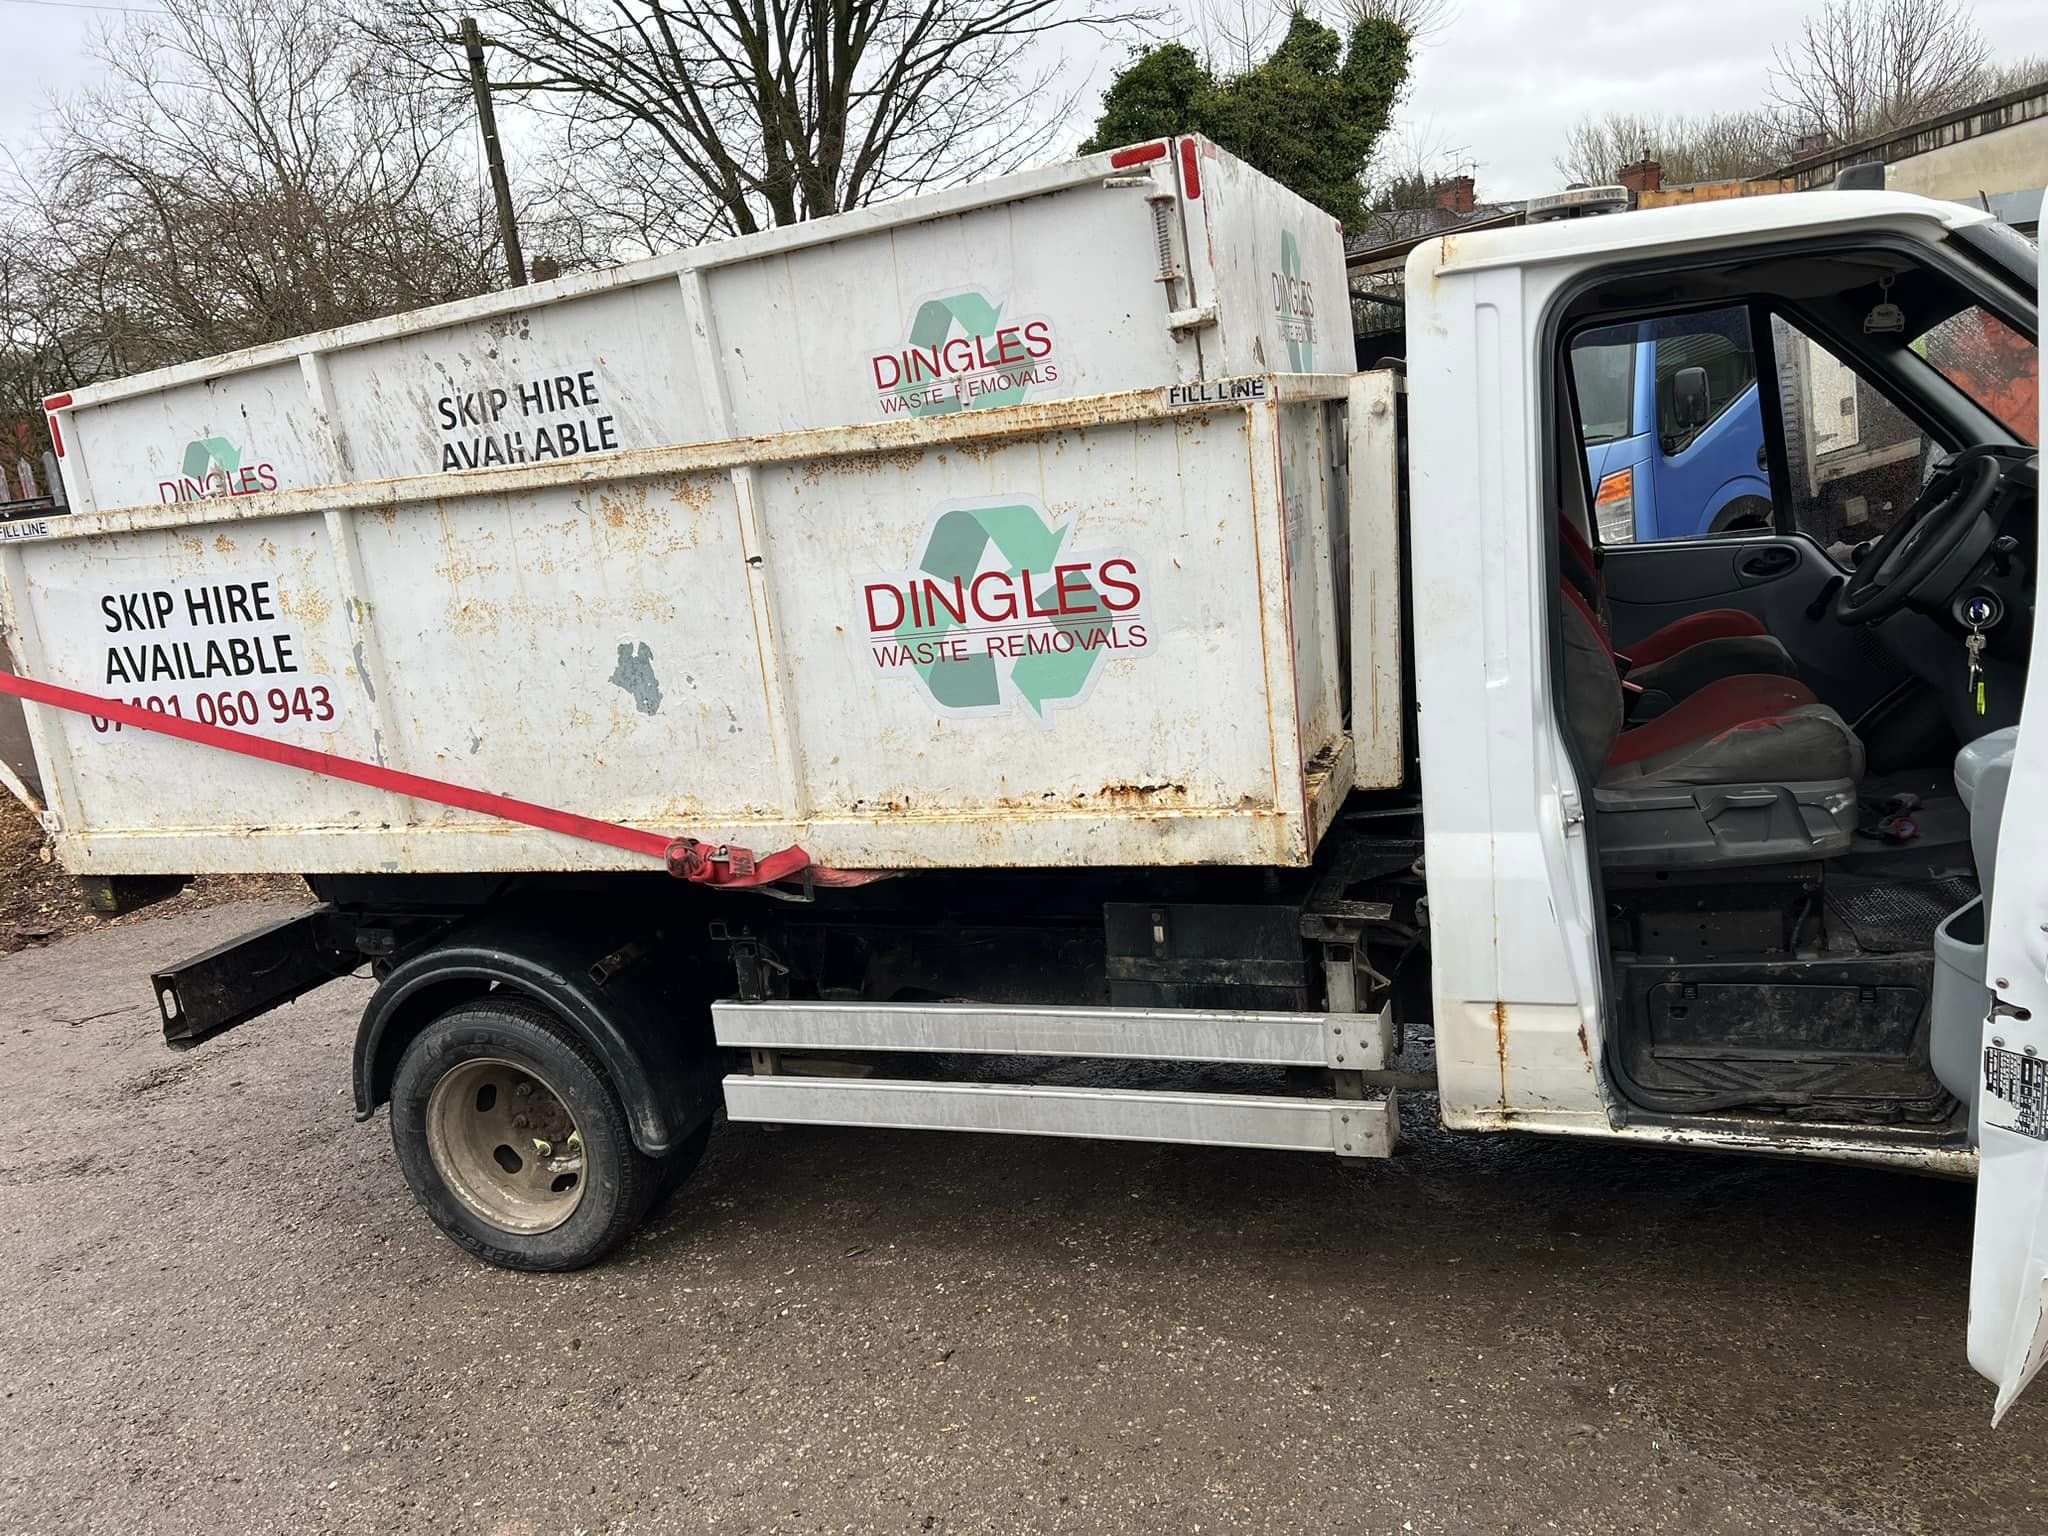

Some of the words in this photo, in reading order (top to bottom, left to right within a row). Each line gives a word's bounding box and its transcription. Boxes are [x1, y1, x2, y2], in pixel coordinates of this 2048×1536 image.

[873, 321, 1052, 390] DINGLES
[438, 387, 507, 431] SKIP
[518, 370, 599, 417] HIRE
[880, 387, 945, 414] WASTE
[1170, 385, 1212, 404] FILL
[1218, 379, 1265, 399] LINE
[442, 415, 619, 472] AVAILABLE
[21, 522, 47, 536] LINE
[101, 591, 174, 633] SKIP
[184, 581, 275, 626] HIRE
[864, 558, 1141, 633] DINGLES
[106, 634, 298, 684] AVAILABLE
[872, 639, 969, 668] WASTE
[986, 624, 1148, 659] REMOVALS
[196, 690, 259, 726] 060
[267, 685, 335, 724] 943
